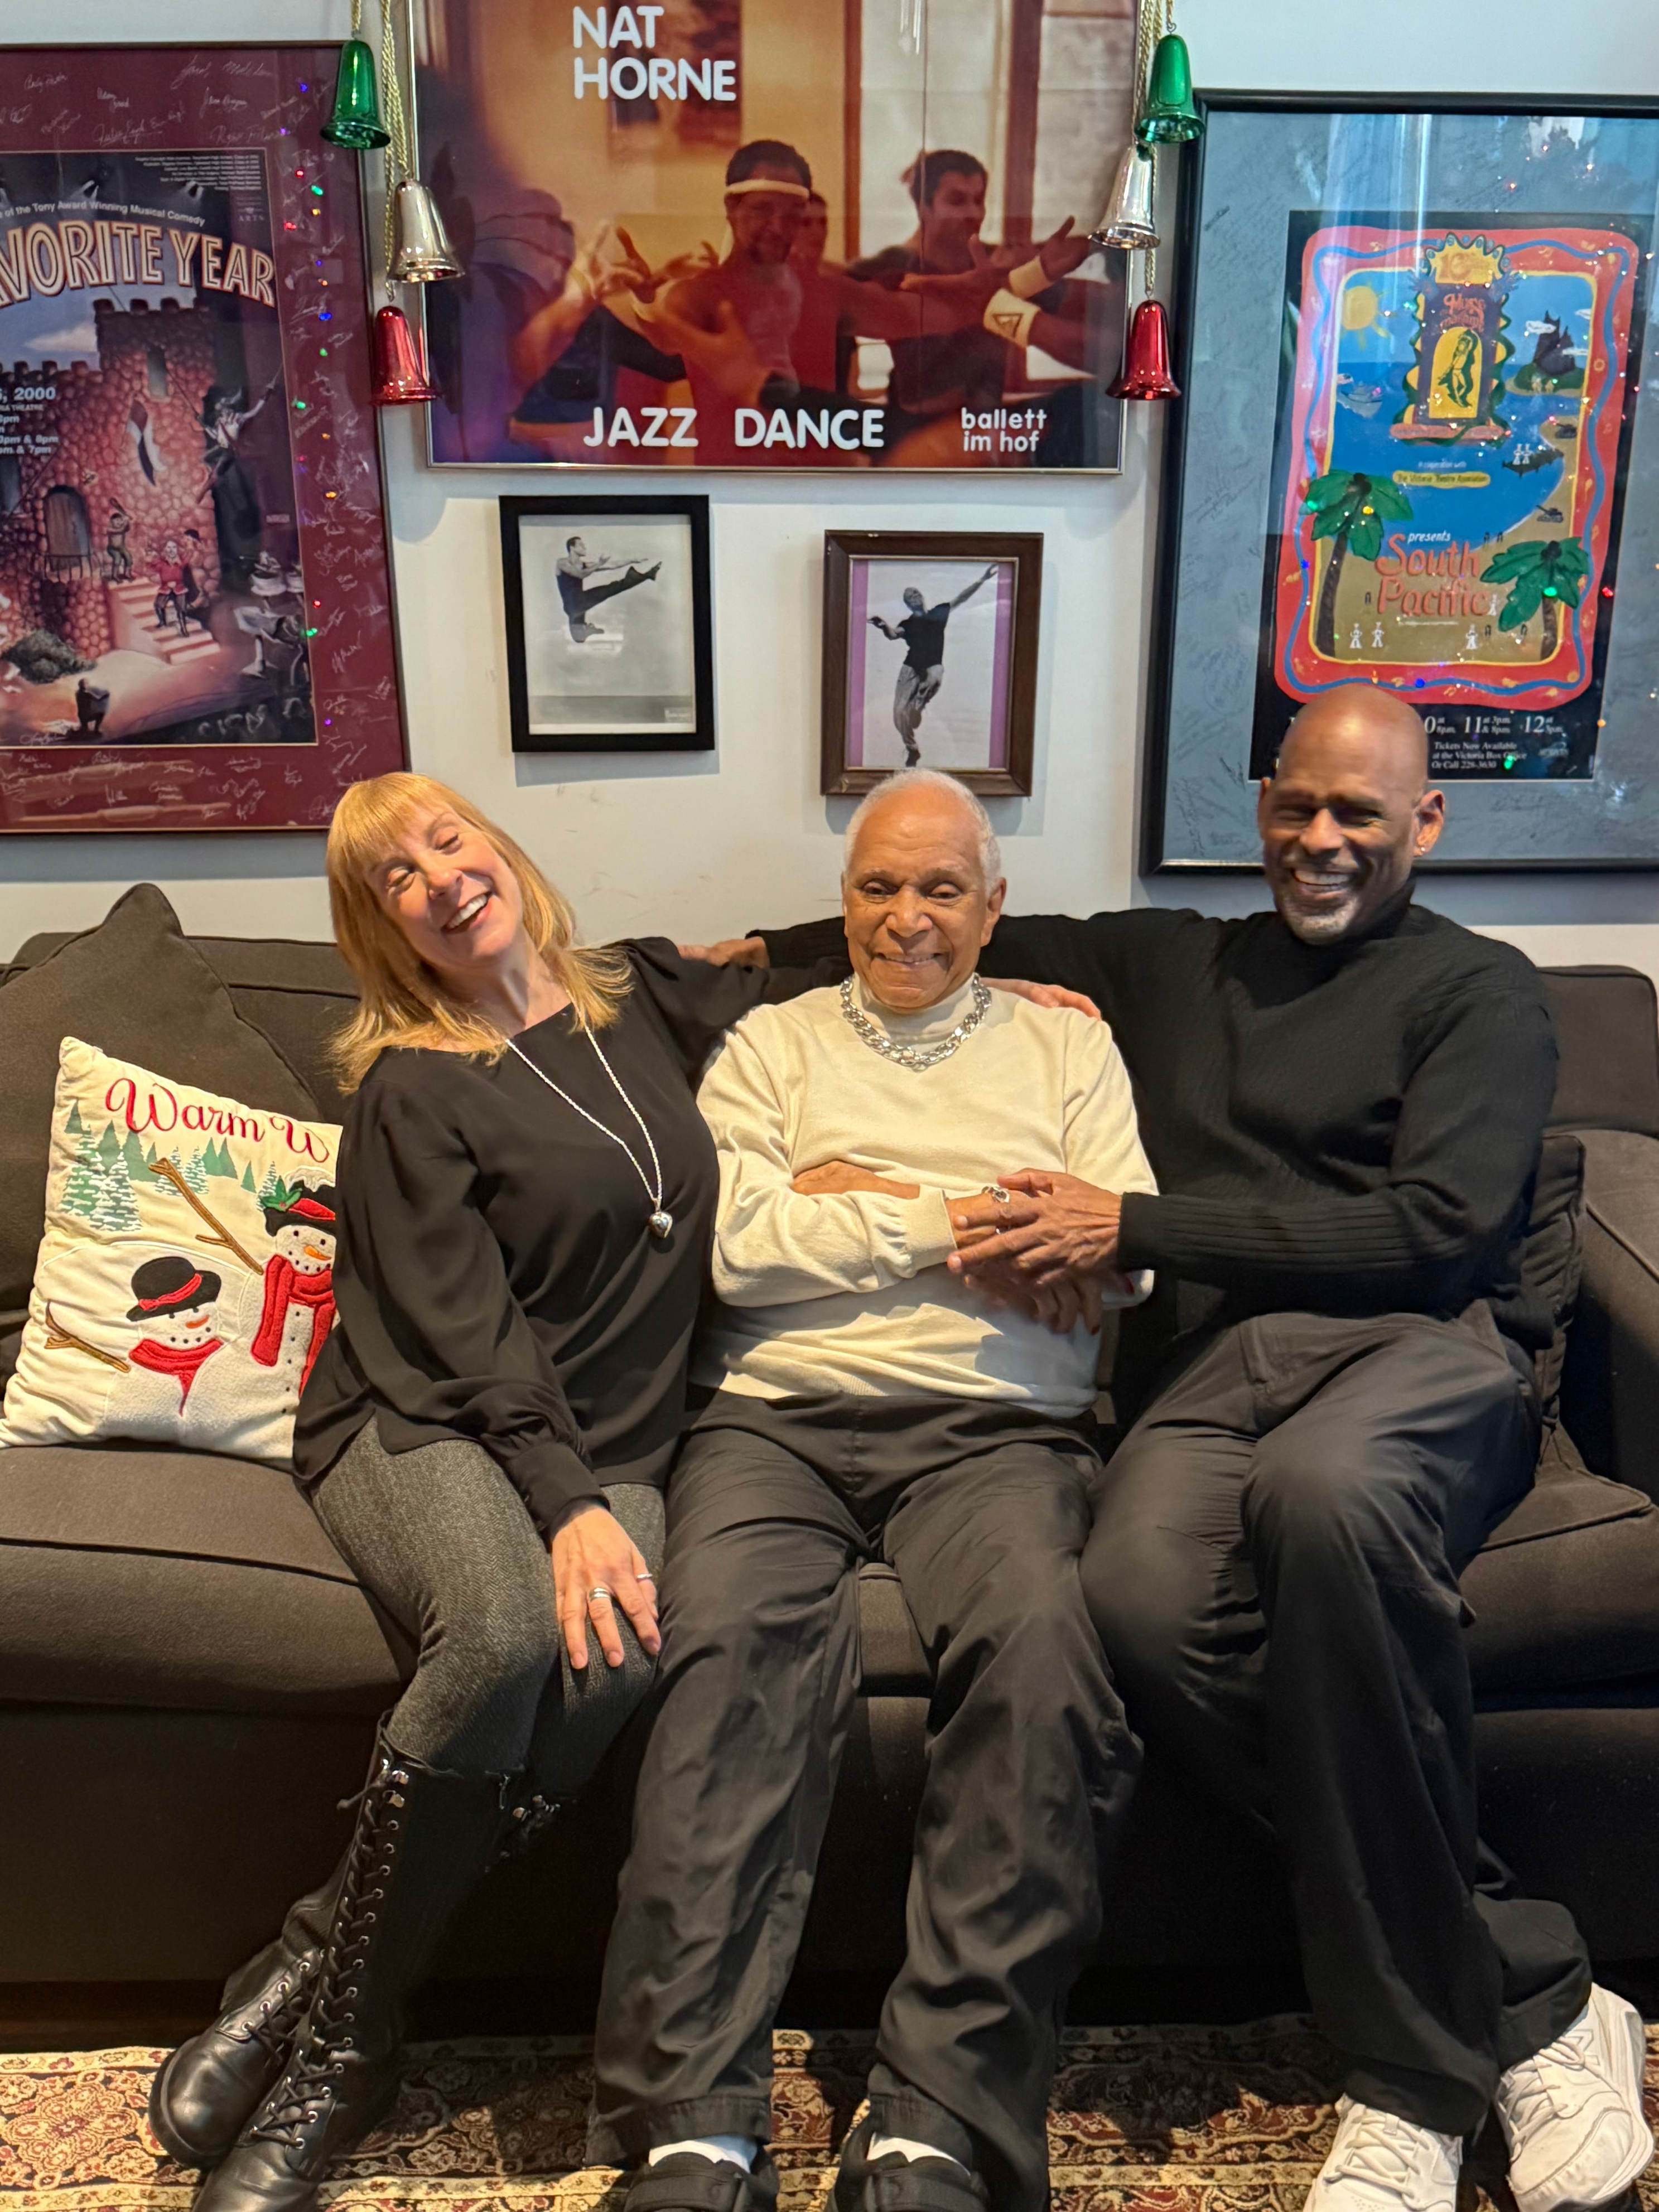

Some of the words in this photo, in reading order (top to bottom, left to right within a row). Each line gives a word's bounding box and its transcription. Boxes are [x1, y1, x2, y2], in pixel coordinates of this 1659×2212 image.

[573, 6, 664, 49] NAT
[574, 57, 736, 101] HORNE
[16, 204, 31, 215] the
[32, 202, 55, 213] Tony
[57, 201, 87, 210] Award
[90, 201, 128, 214] Winning
[130, 204, 166, 218] Musical
[167, 210, 206, 226] Comedy
[169, 228, 276, 308] YEAR
[14, 387, 56, 400] 2000
[583, 407, 698, 447] JAZZ
[735, 408, 885, 450] DANCE
[961, 407, 1047, 429] ballett
[963, 430, 991, 452] im
[1000, 429, 1039, 452] hof
[1407, 530, 1451, 544] presents
[1375, 533, 1479, 577] South
[1377, 576, 1491, 616] Pacific
[1424, 716, 1436, 734] 0
[1464, 716, 1482, 733] 11
[1524, 716, 1545, 733] 12
[1431, 761, 1442, 769] Or
[1443, 760, 1459, 769] Call
[105, 1078, 266, 1142] Warm
